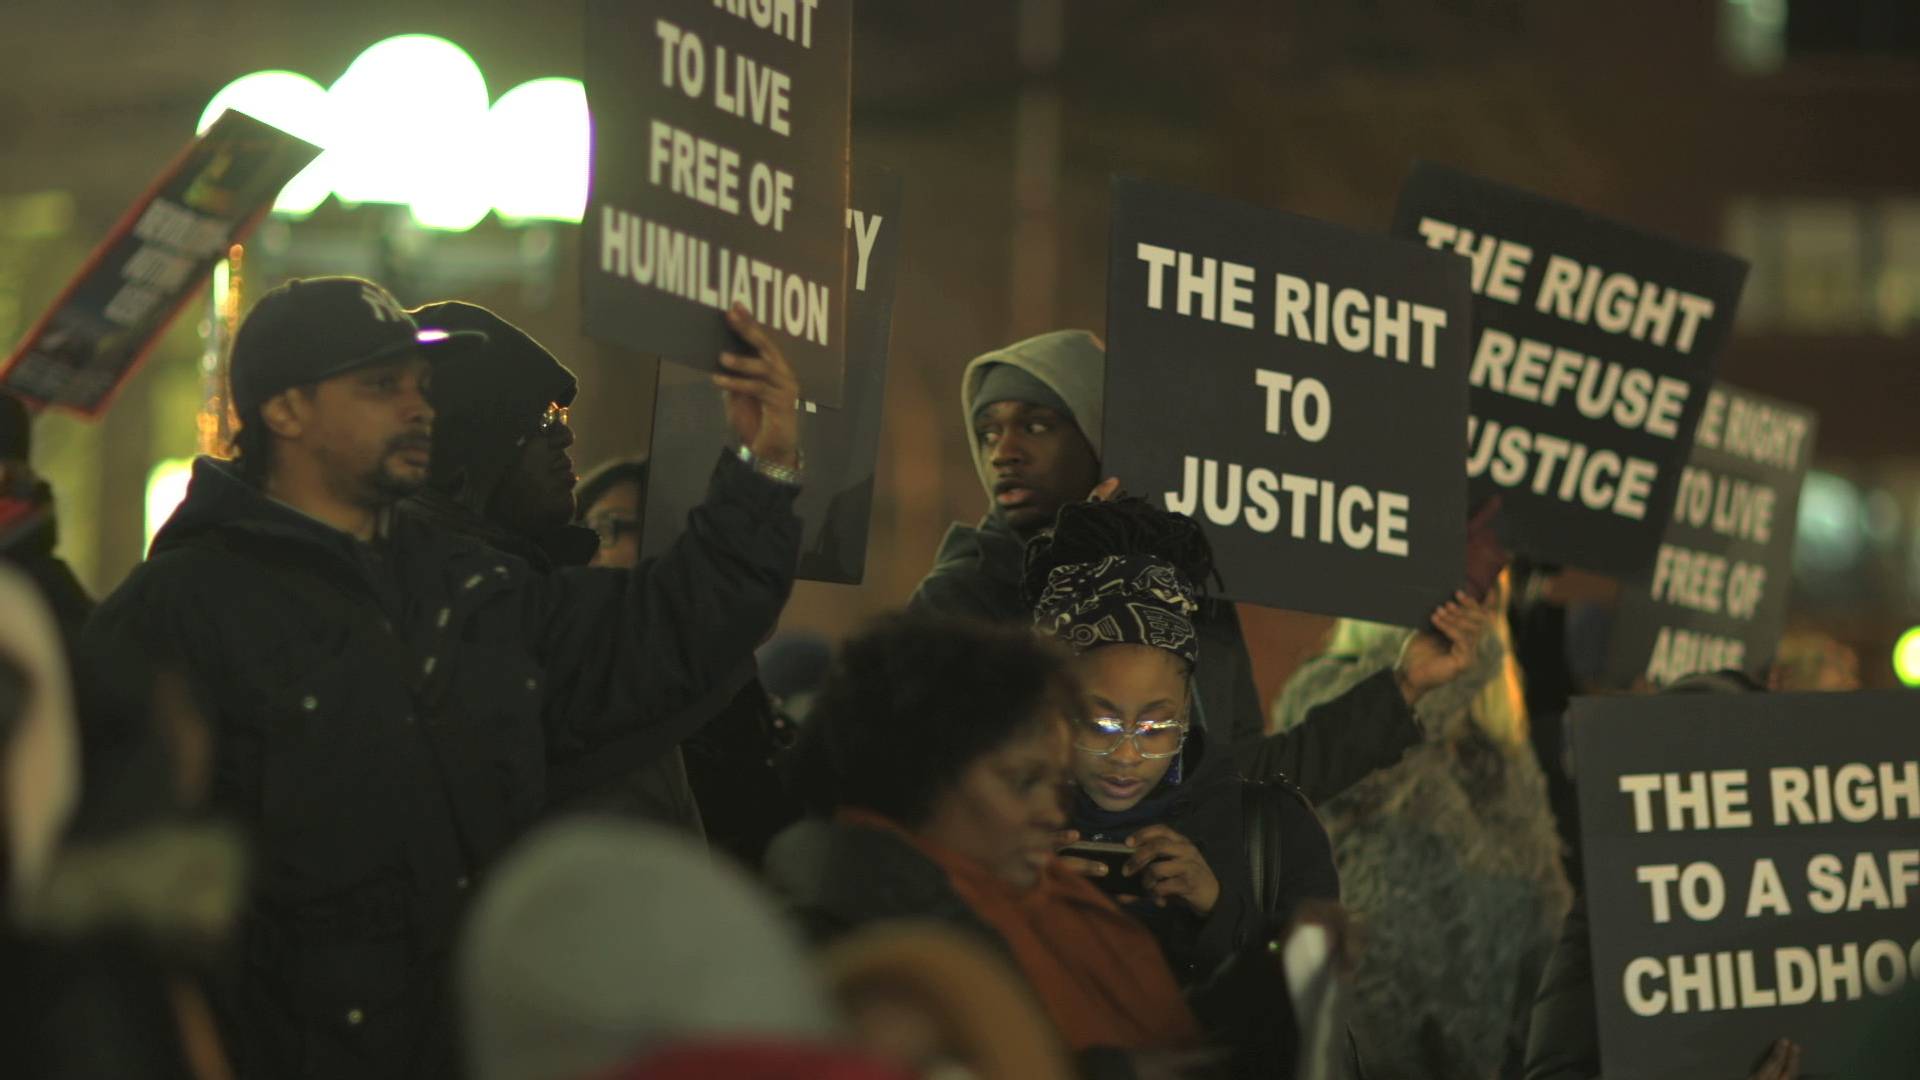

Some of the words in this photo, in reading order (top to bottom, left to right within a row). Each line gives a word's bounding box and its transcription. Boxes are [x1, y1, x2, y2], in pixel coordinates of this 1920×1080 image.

[656, 19, 704, 98] TO
[715, 46, 791, 136] LIVE
[650, 120, 740, 215] FREE
[749, 162, 793, 231] OF
[601, 205, 829, 346] HUMILIATION
[1137, 242, 1256, 329] THE
[1274, 273, 1447, 369] RIGHT
[1419, 216, 1533, 305] THE
[1536, 255, 1715, 355] RIGHT
[1256, 368, 1331, 442] TO
[1469, 328, 1691, 440] REFUSE
[1724, 397, 1806, 470] RIGHT
[1164, 456, 1410, 557] JUSTICE
[1712, 477, 1776, 544] LIVE
[1651, 544, 1727, 613] FREE
[1727, 561, 1767, 620] OF
[1619, 769, 1752, 833] THE
[1636, 861, 1725, 923] TO
[1746, 858, 1791, 917] A
[1623, 939, 1920, 1017] CHILDHO
